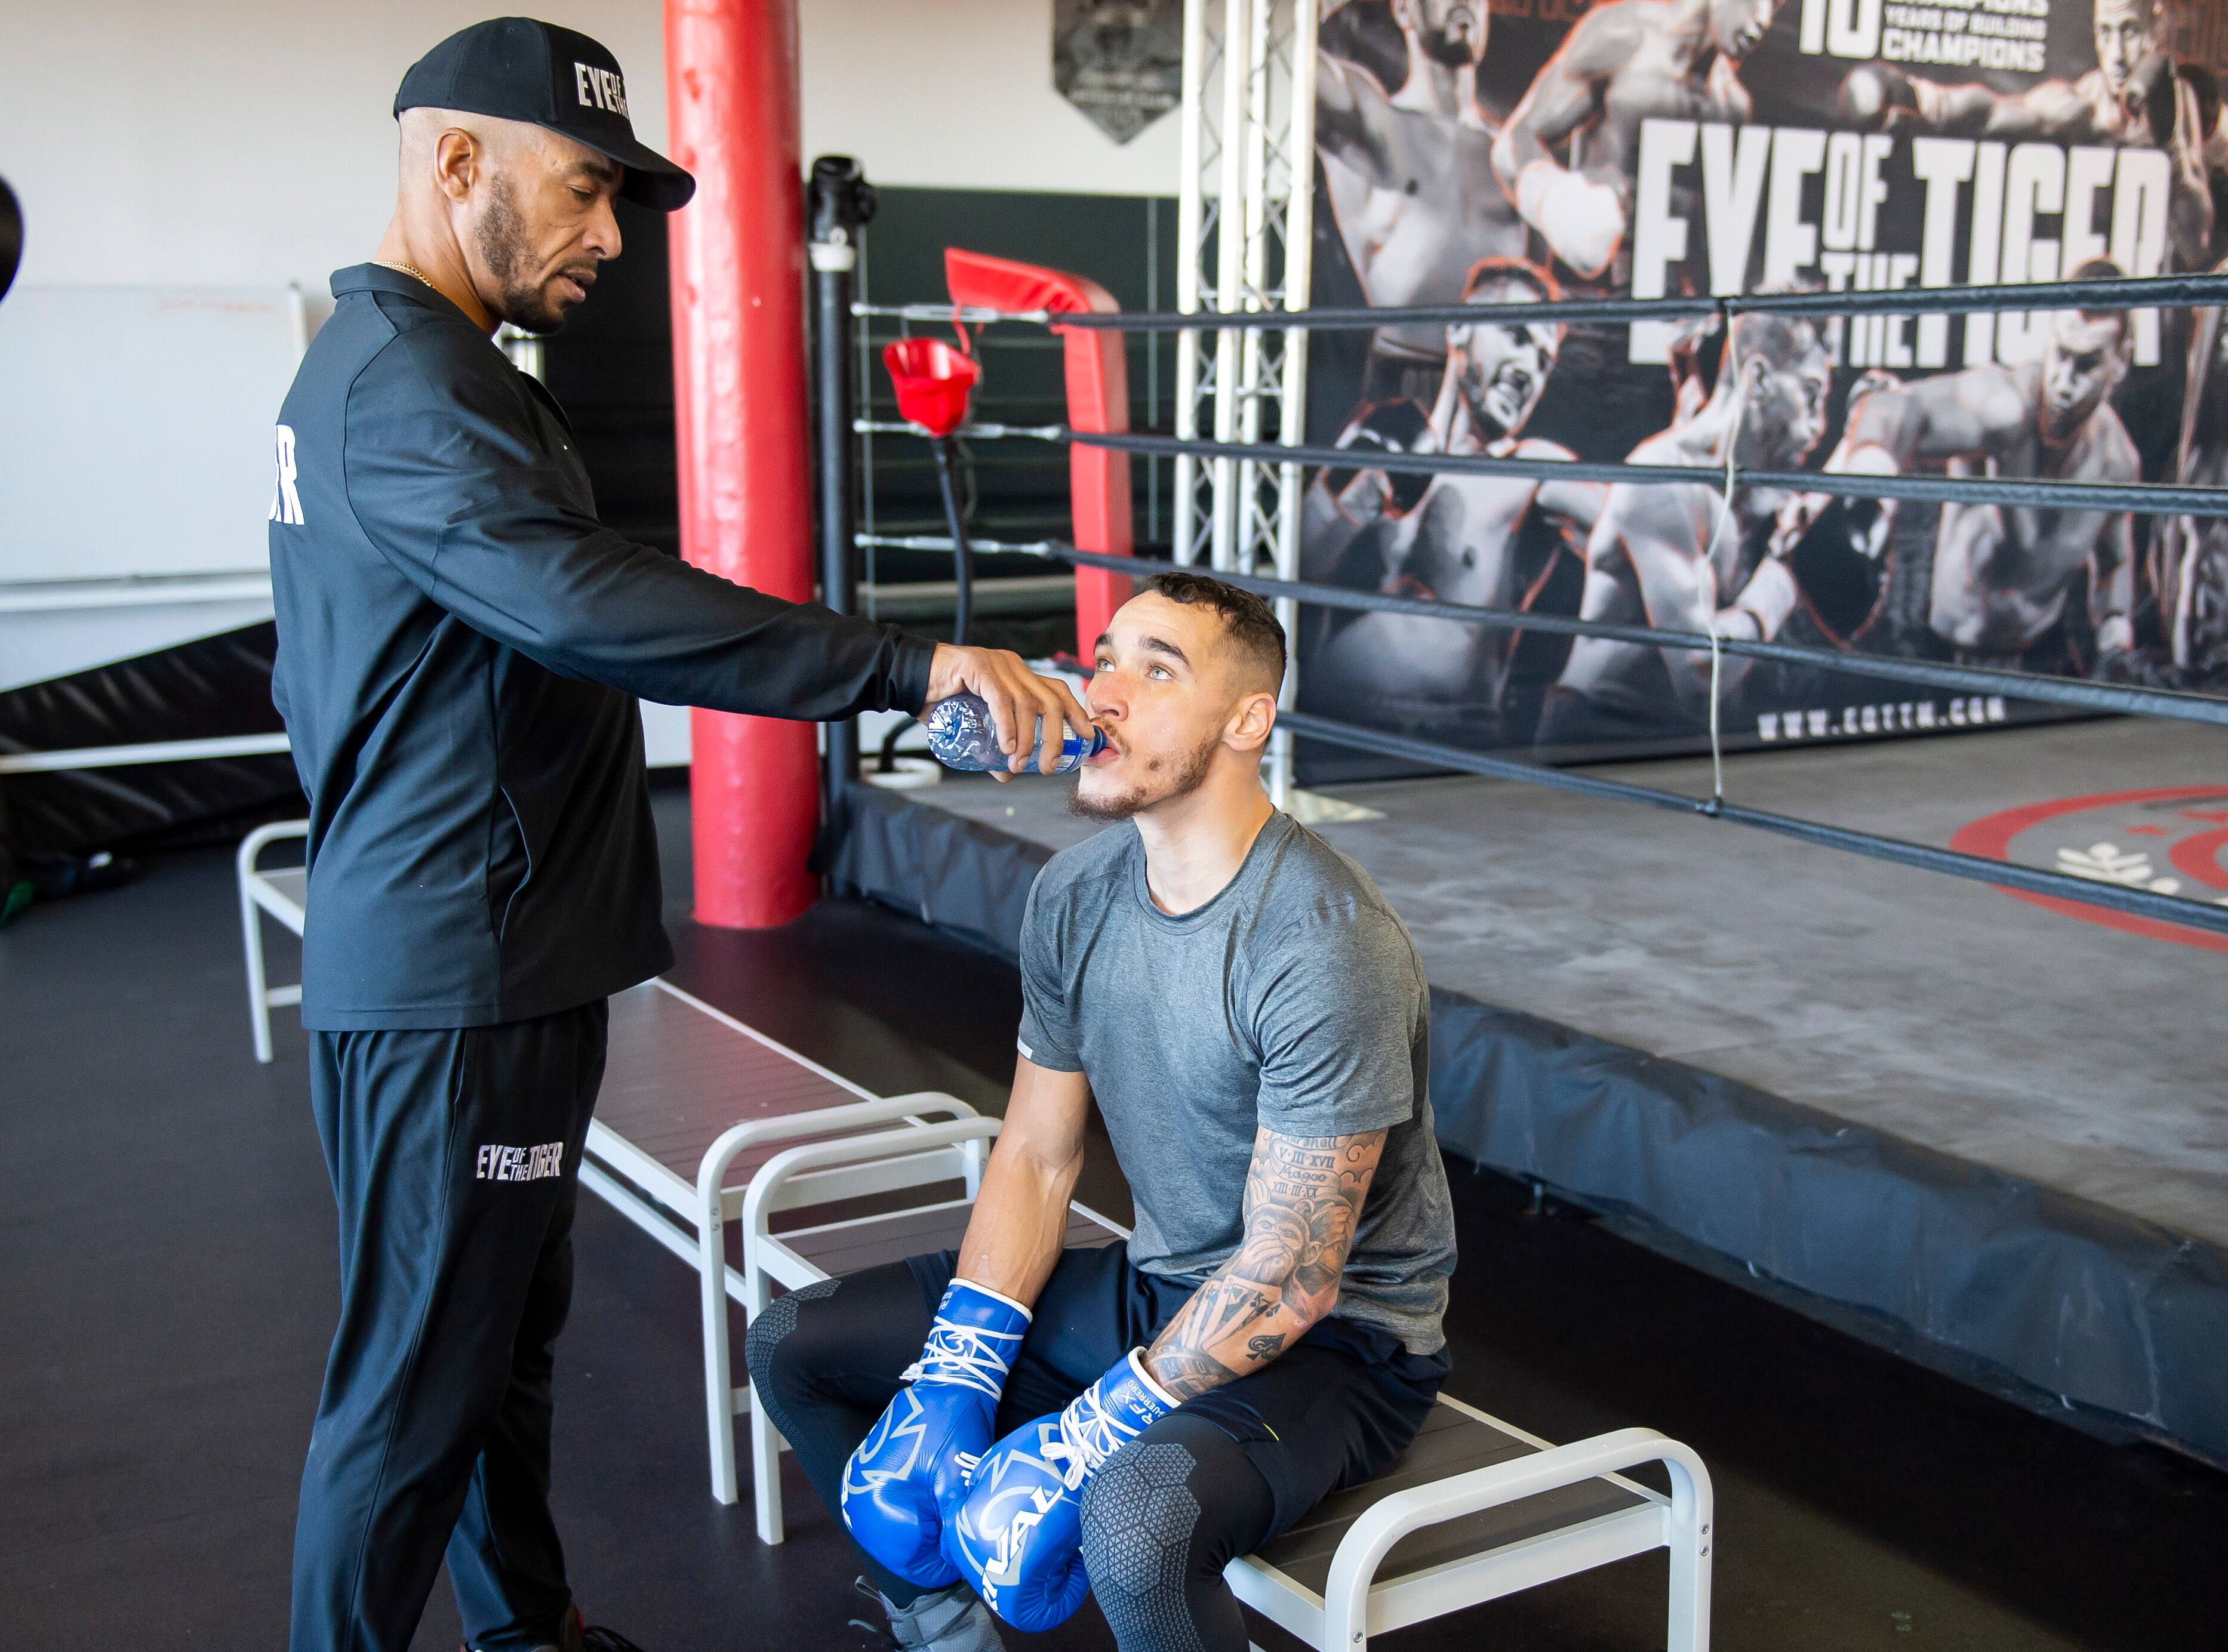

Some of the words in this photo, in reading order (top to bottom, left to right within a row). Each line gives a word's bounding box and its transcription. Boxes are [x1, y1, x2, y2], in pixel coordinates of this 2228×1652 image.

[1885, 6, 1942, 30] YEARS
[1943, 10, 1969, 33] OF
[1969, 12, 2047, 41] BUILDING
[1881, 28, 2045, 72] CHAMPIONS
[574, 62, 617, 112] EYE
[1823, 132, 1892, 251] OF
[477, 1145, 516, 1180] EYE
[510, 1164, 529, 1181] THE
[513, 1147, 527, 1164] OF
[526, 1142, 564, 1181] TIGER
[1119, 1390, 1153, 1425] RFX
[981, 1485, 1064, 1613] RIVAL
